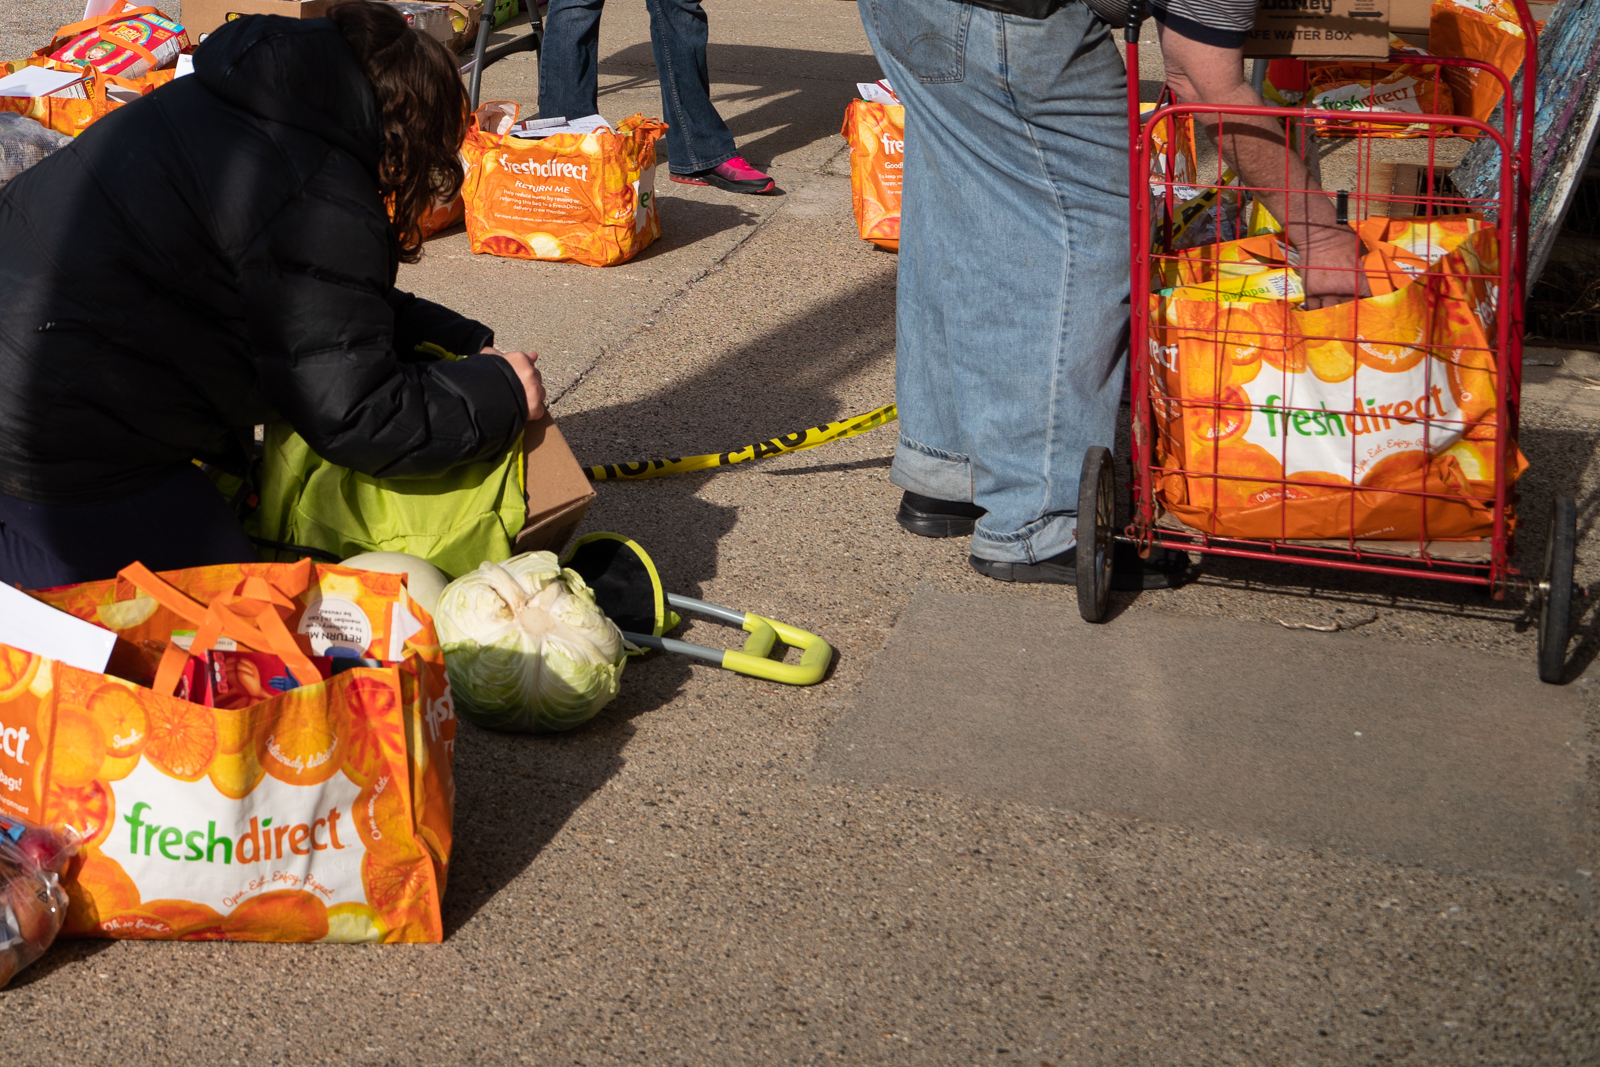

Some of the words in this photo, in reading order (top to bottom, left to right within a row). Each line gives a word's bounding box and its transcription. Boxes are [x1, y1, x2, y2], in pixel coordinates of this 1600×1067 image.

[1249, 30, 1276, 40] AFE
[1279, 30, 1320, 40] WATER
[1325, 30, 1352, 40] BOX
[500, 154, 588, 182] freshdirect
[515, 181, 553, 193] RETURN
[500, 196, 521, 204] returning
[1260, 385, 1447, 437] freshdirect
[322, 633, 361, 643] RETURN
[124, 801, 345, 865] freshdirect
[371, 816, 382, 840] One
[103, 920, 120, 931] Oh
